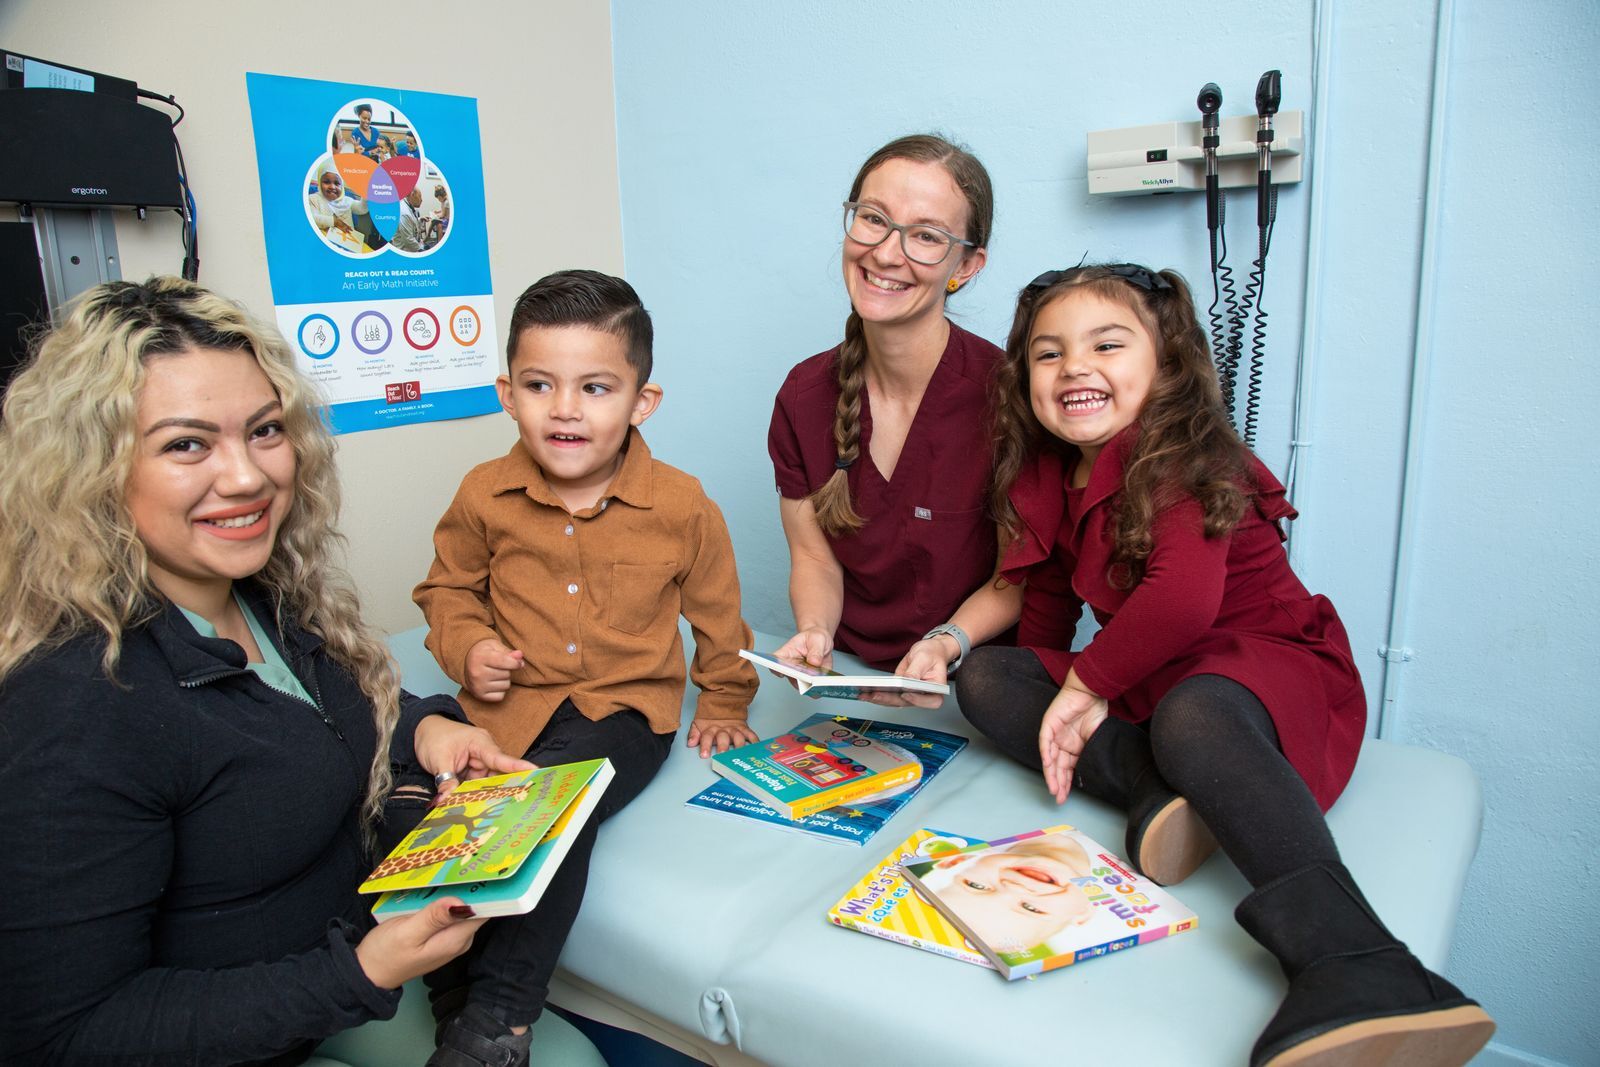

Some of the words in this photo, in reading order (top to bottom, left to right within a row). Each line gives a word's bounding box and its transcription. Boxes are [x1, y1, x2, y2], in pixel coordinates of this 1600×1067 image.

[71, 187, 108, 195] ergotron
[342, 282, 355, 290] An
[357, 281, 379, 291] Early
[381, 279, 404, 289] Math
[405, 278, 439, 288] Initiative
[731, 758, 754, 771] lento
[762, 765, 782, 775] and
[755, 771, 786, 791] Rápido
[698, 794, 722, 804] luna
[735, 797, 759, 805] moon
[735, 803, 776, 817] bájame
[808, 819, 830, 827] por
[458, 822, 524, 876] escondido
[839, 877, 894, 916] What's
[1092, 866, 1161, 914] faces
[867, 898, 898, 922] ¿Qué
[892, 887, 909, 898] es
[1069, 876, 1147, 928] smiley
[1078, 946, 1107, 960] smiley
[1109, 939, 1135, 952] faces
